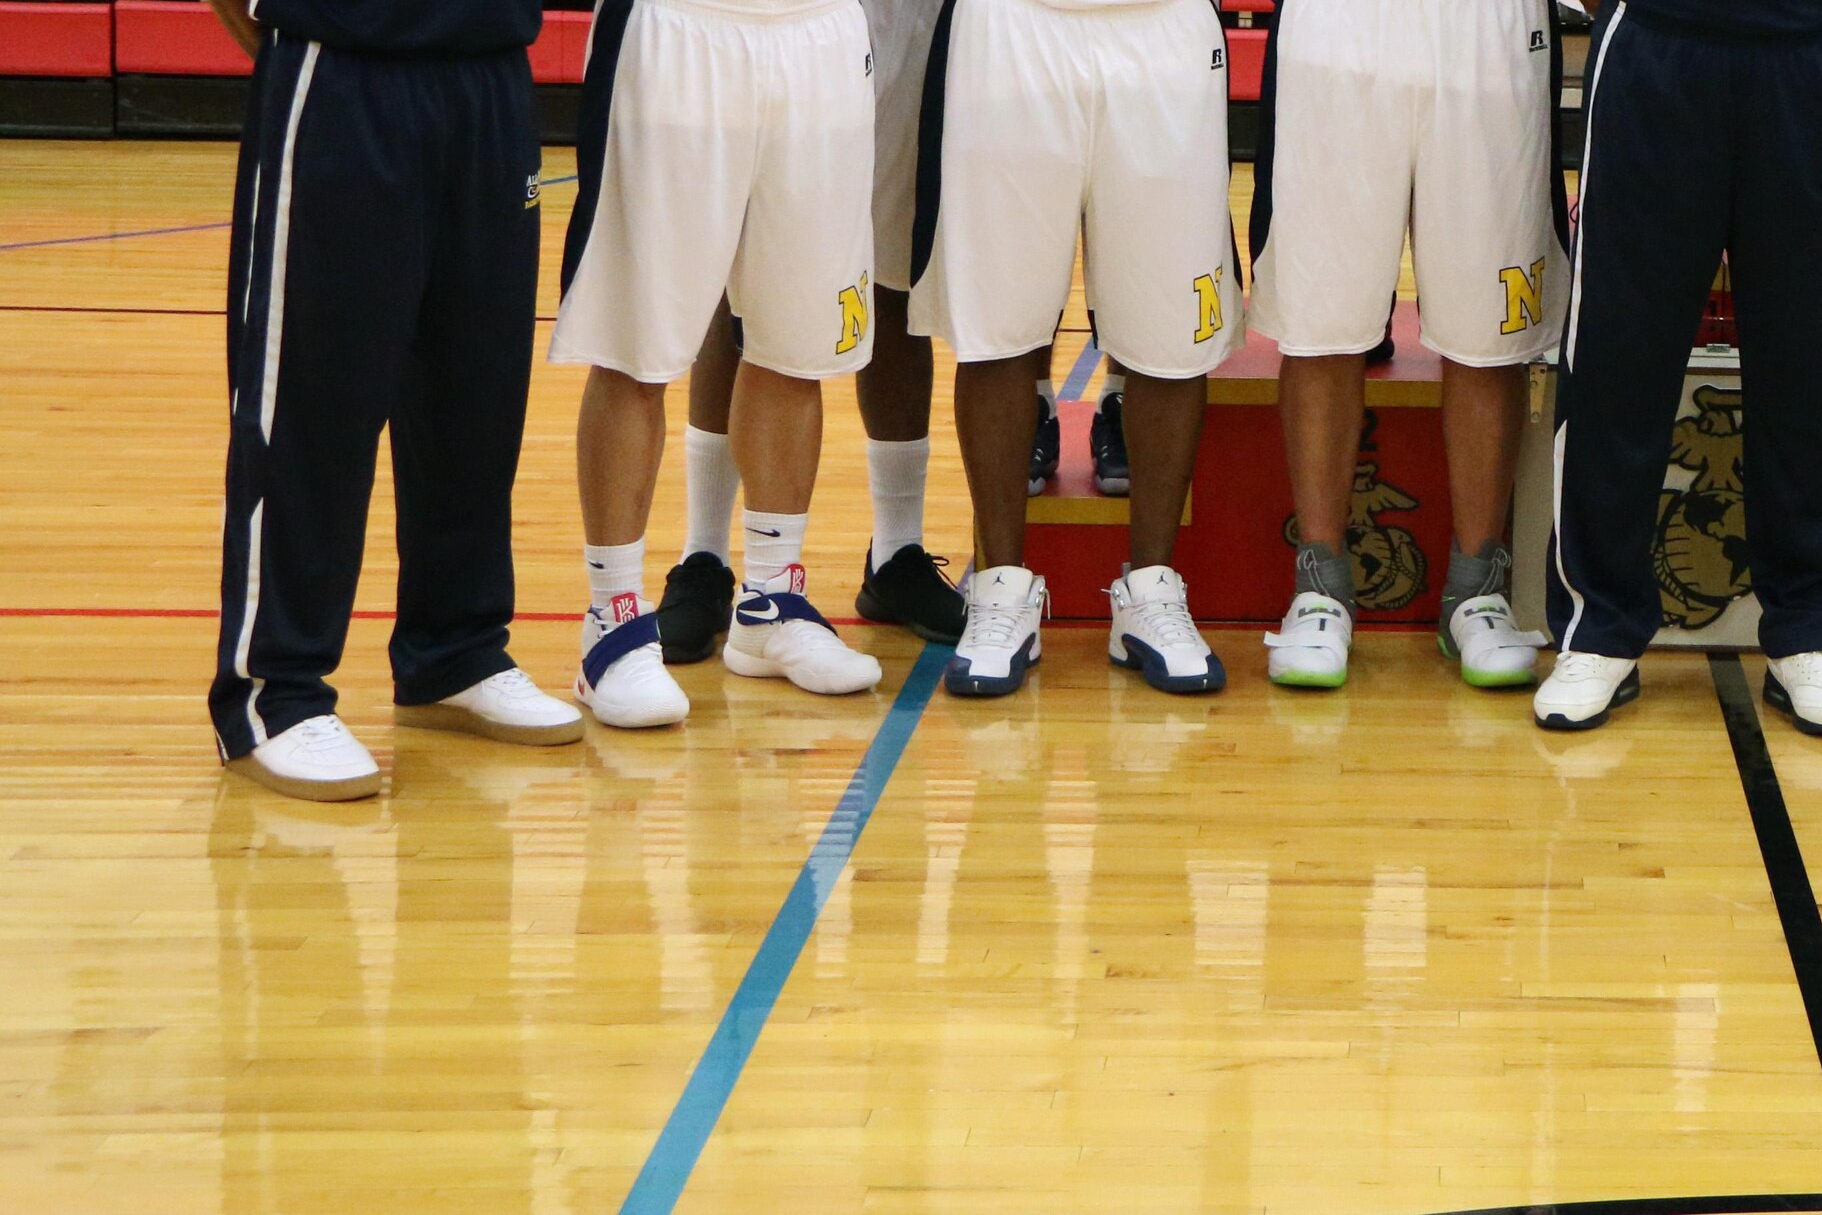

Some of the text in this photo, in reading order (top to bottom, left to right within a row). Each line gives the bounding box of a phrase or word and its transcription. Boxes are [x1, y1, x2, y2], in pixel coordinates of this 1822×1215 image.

[835, 270, 868, 355] N
[1194, 264, 1223, 344] N
[1499, 256, 1546, 335] N
[1358, 408, 1379, 453] 2
